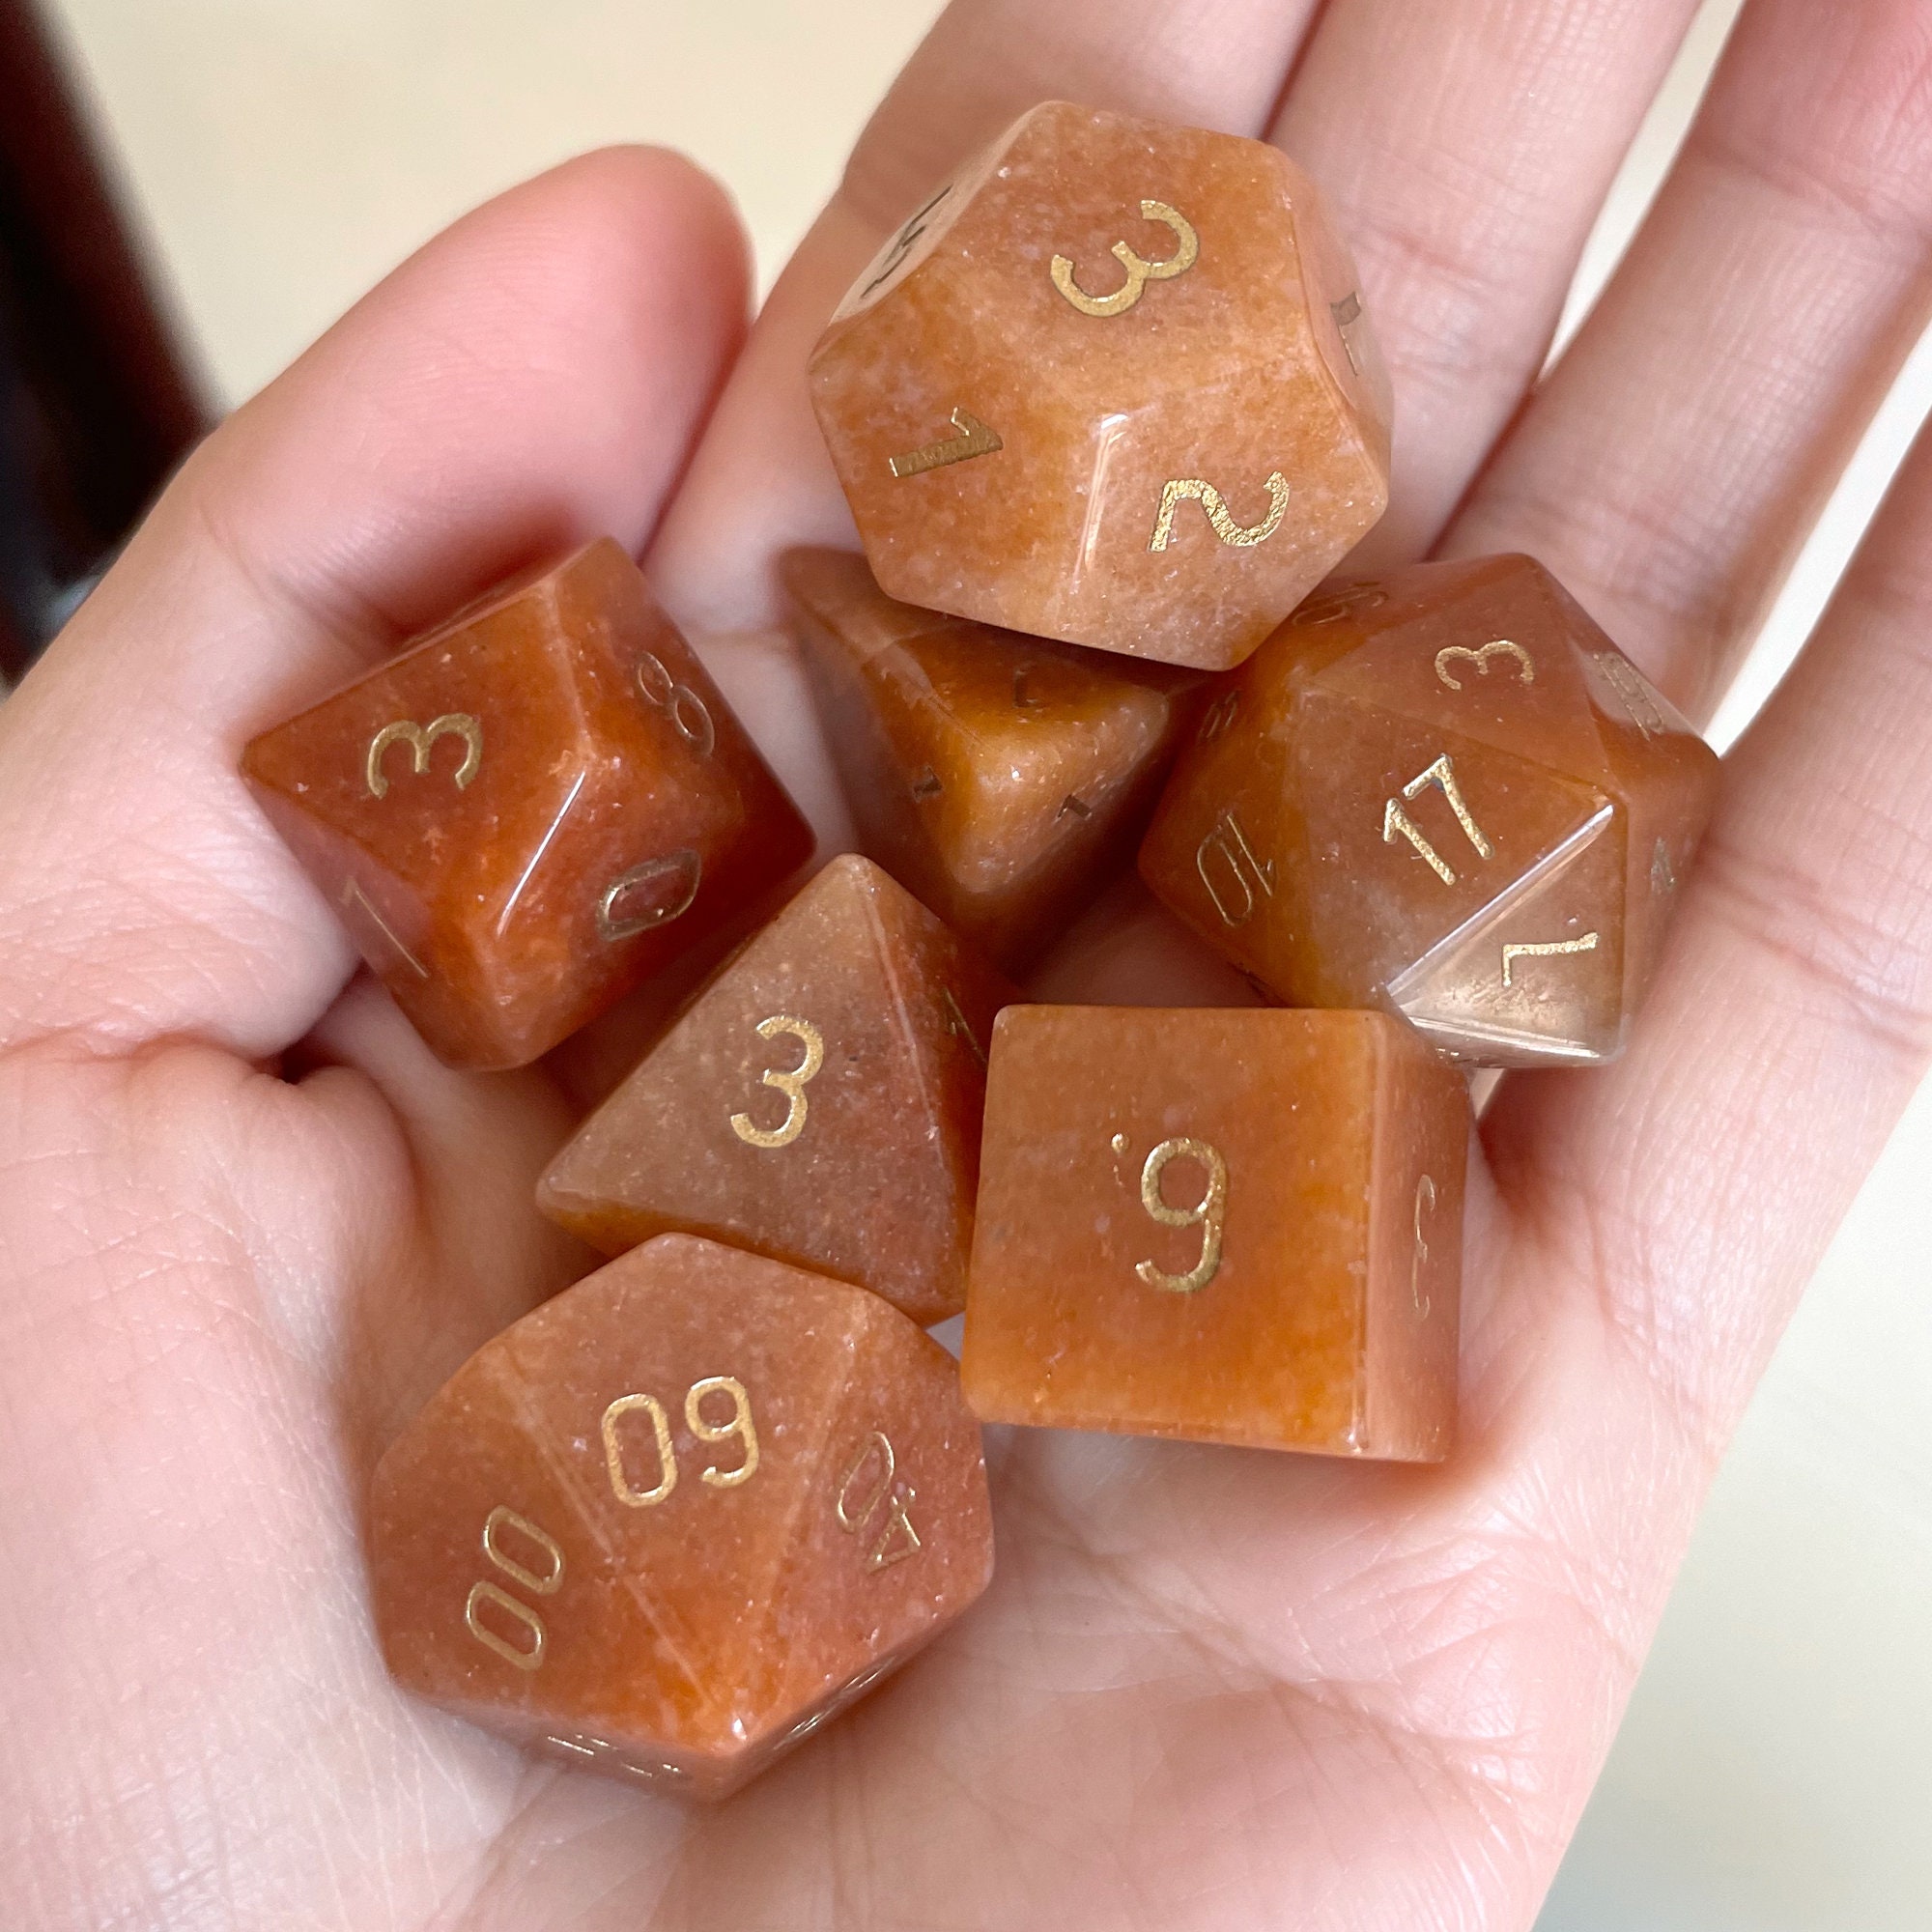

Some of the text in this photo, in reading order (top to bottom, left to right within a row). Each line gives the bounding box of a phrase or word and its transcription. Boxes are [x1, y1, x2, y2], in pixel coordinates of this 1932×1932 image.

[1050, 199, 1200, 318] 3
[888, 406, 1004, 477] 1
[1148, 469, 1290, 553] 2
[634, 650, 716, 759] 8
[1434, 639, 1535, 691] 3
[365, 711, 483, 801] 3
[1382, 752, 1495, 886] 17
[595, 849, 702, 942] 0
[1501, 931, 1599, 987] 7
[729, 1015, 826, 1149] 3
[464, 1504, 566, 1671] 00
